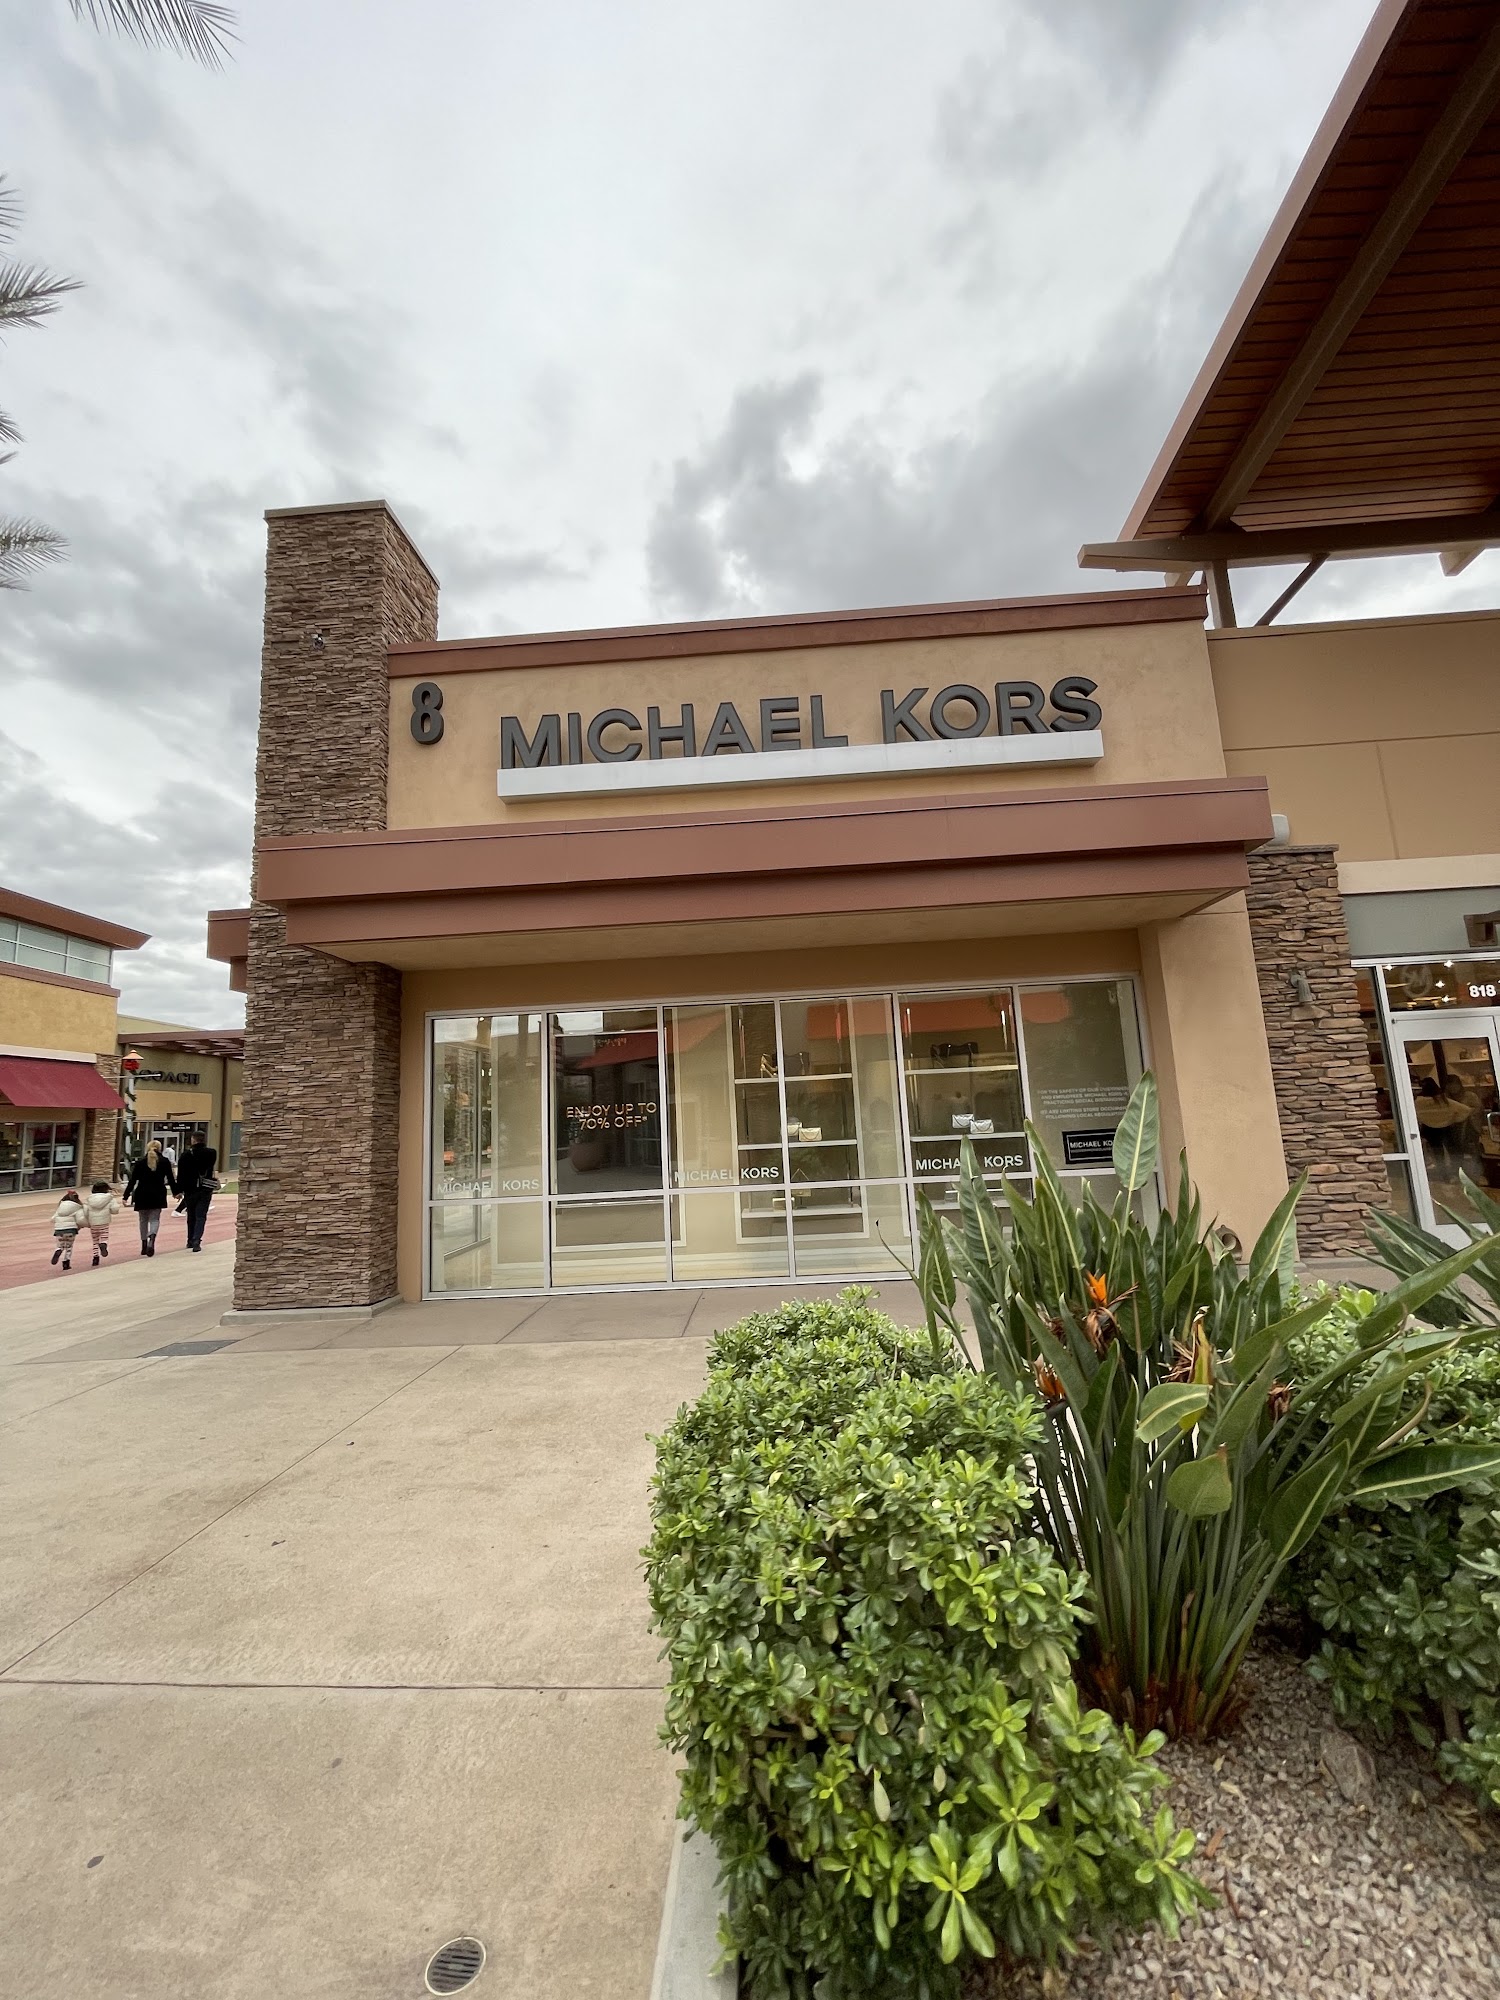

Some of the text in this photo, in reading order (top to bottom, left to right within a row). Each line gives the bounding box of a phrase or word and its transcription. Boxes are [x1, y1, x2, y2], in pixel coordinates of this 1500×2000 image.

[411, 682, 444, 745] 8
[500, 676, 1102, 769] MICHAEL KORS
[1469, 984, 1497, 998] 818
[139, 1069, 200, 1085] COACH
[566, 1101, 657, 1118] ENJOY UP TO
[579, 1117, 611, 1131] 70%
[1070, 1141, 1101, 1149] MICHAEL
[915, 1155, 1024, 1170] MICHA KORS
[674, 1166, 779, 1183] MICHAEL KORS
[502, 1179, 539, 1191] KORS
